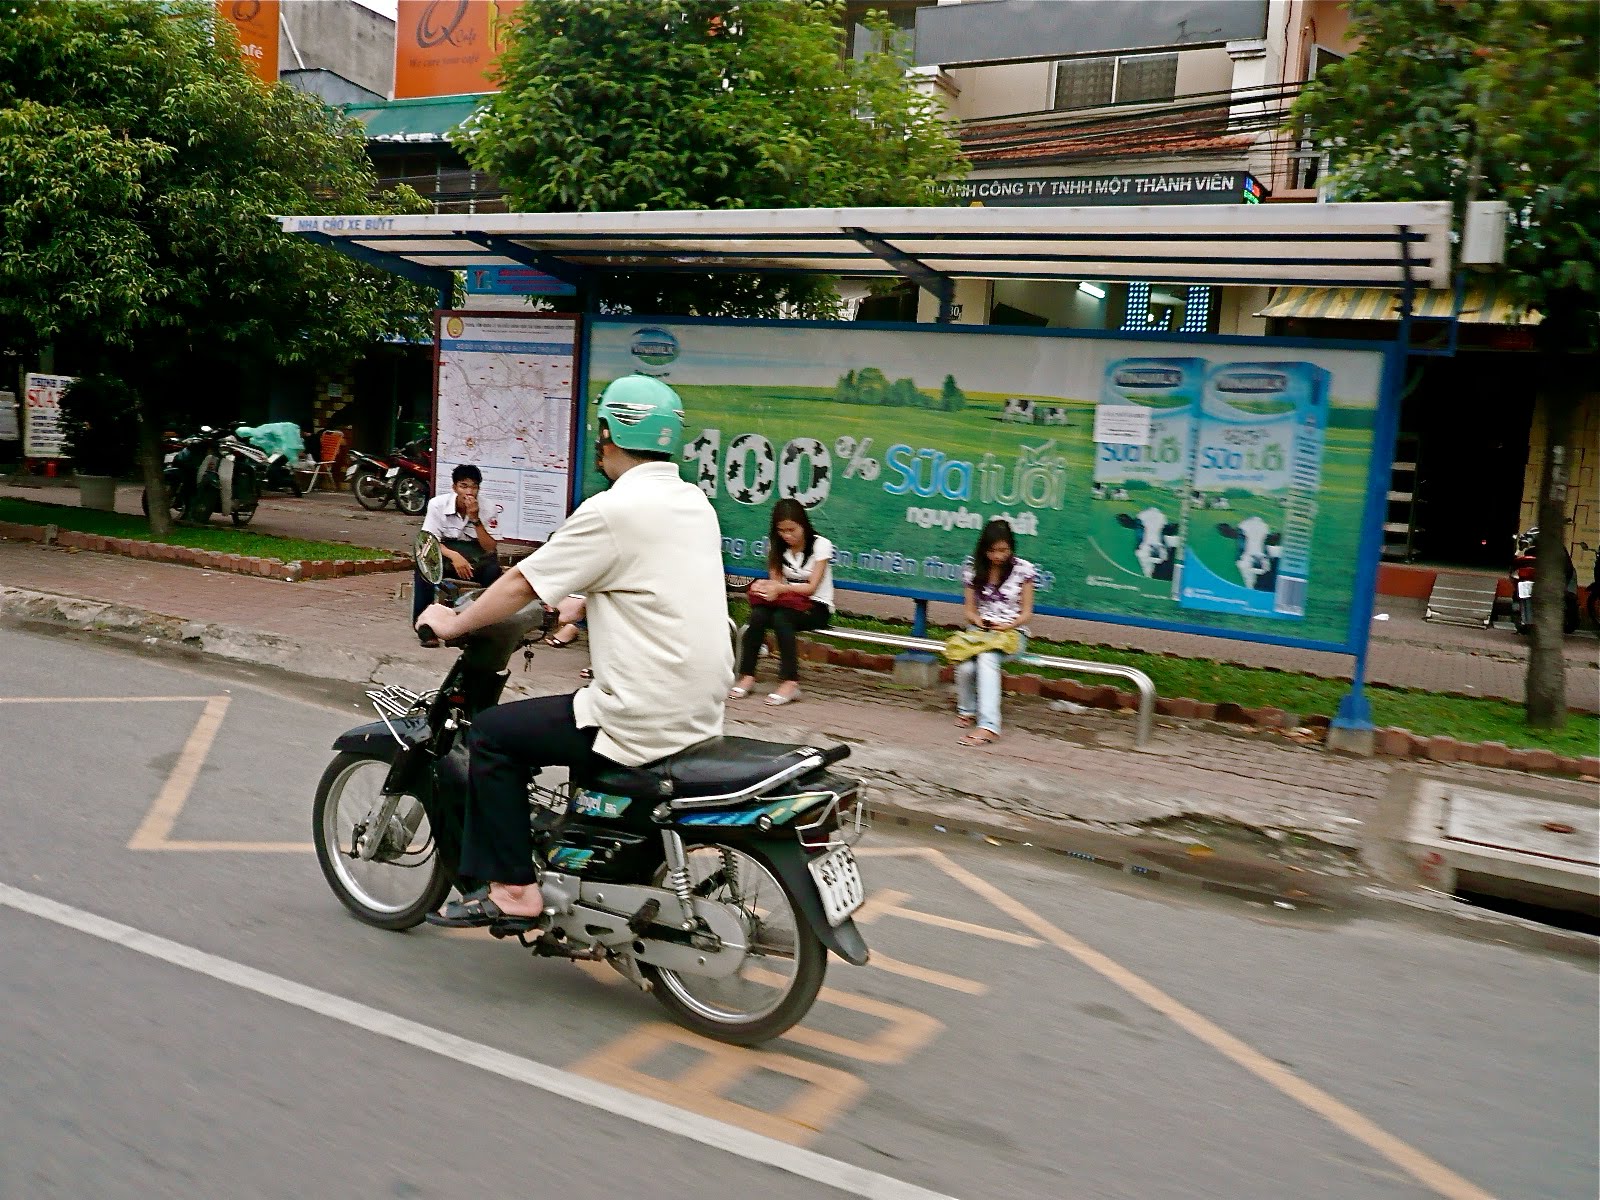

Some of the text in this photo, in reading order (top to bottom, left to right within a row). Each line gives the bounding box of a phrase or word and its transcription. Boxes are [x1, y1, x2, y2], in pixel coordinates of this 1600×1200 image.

[978, 180, 1025, 198] CÔNG
[1026, 180, 1047, 196] TY
[1050, 179, 1093, 196] TNHH
[1095, 176, 1132, 196] MỘT
[1135, 174, 1193, 194] THÀNH
[1194, 172, 1235, 192] VIÊN
[882, 443, 974, 502] Sữa
